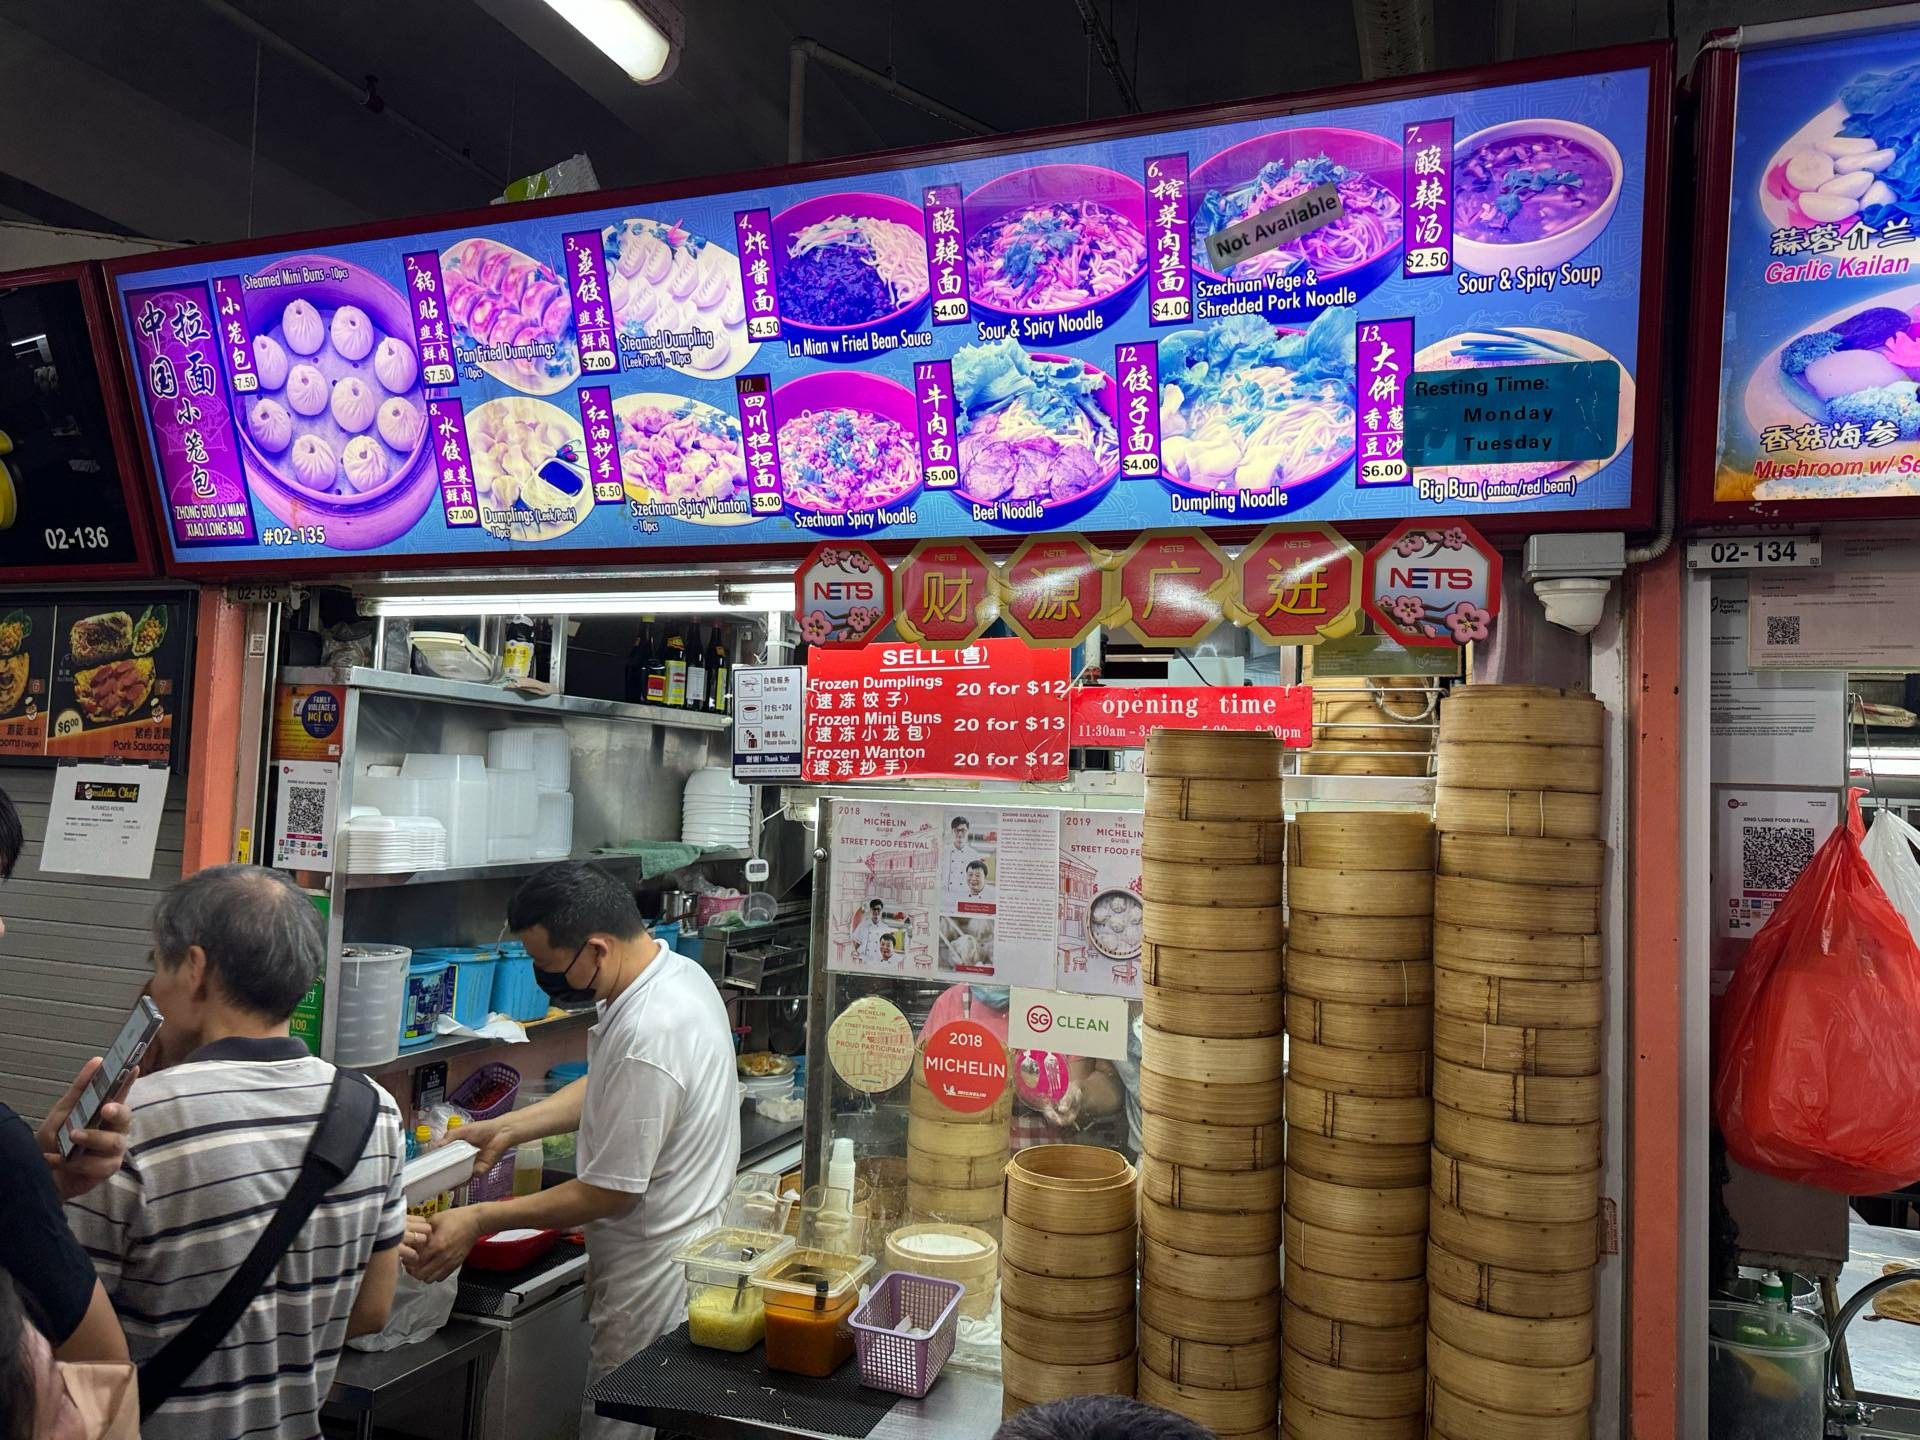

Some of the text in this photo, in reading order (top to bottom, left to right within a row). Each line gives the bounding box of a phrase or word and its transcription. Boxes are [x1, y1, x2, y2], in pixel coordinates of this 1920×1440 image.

[1410, 145, 1447, 244] 酸辣汤
[1149, 178, 1187, 293] 榨菜肉丝面
[1216, 194, 1337, 258] Not Available
[1770, 218, 1916, 256] 蒜蓉介兰
[931, 207, 963, 295] 酸辣面
[1405, 252, 1449, 268] $2.50
[244, 267, 325, 290] Steamed Mini Buns
[577, 248, 603, 303] 蒸饺
[744, 231, 774, 312] 炸酱面
[1458, 262, 1602, 294] Sour Spicy Soup
[1765, 256, 1910, 285] Garlic Kailan
[412, 270, 438, 319] 锅贴
[1198, 272, 1301, 298] Szechuan Vege
[933, 303, 966, 318] $4.00
[1152, 301, 1191, 317] $4.00
[1198, 286, 1357, 318] Shredded Pork Noodle
[221, 297, 251, 371] 小笼包
[748, 320, 780, 335] $4.50
[978, 311, 1103, 341] Sour Spicy Noodle
[170, 301, 217, 397] 拉面
[620, 328, 714, 351] Steamed Dumpling
[788, 329, 932, 357] La Mian Fried Bean Sauce
[138, 304, 177, 398] 中国
[456, 339, 555, 363] Pan Fried Dumplings
[582, 356, 611, 369] $7.00
[623, 353, 666, 371] (Leek/Pork)
[232, 375, 257, 389] $7.50
[424, 367, 452, 382] $7.50
[1367, 341, 1399, 405] 大饼
[1415, 376, 1550, 398] Resting Time:
[1122, 365, 1155, 452] 饺子面
[1464, 408, 1554, 423] Monday
[922, 383, 952, 462] 牛肉面
[438, 416, 463, 463] 水饺
[587, 405, 615, 480] 红油抄手
[743, 395, 776, 489] 四川担担面
[1464, 436, 1553, 452] Tuesday
[1761, 420, 1901, 452] 香菇海参
[176, 398, 218, 498] 小笼包
[924, 470, 956, 482] $5.00
[1362, 463, 1403, 478] $6.00
[1754, 459, 1864, 480] Mushroom
[593, 485, 621, 498] $6.50
[1419, 475, 1577, 502] Big Bun (onion/red bean)
[175, 503, 247, 519] ZHONG GUO LA MIAN
[631, 497, 748, 518] Szechuan Wanton
[751, 496, 781, 508] $5.00
[972, 501, 1044, 521] Beef Noodle
[1171, 487, 1288, 514] Dumpling Noodle
[448, 510, 474, 521] $7.00
[484, 507, 534, 525] Dumplings
[847, 505, 917, 529] Spicy Noodle
[45, 527, 109, 550] 02-136
[186, 521, 245, 537] XIAO LONG BAO
[262, 526, 326, 546] #02-135
[1711, 542, 1797, 562] 02-134
[1390, 568, 1472, 589] NETS
[237, 586, 278, 600] 02-135
[814, 581, 874, 601] NETS
[923, 556, 1328, 624] 财 源 广 进
[882, 646, 988, 666] SELL (售)
[810, 674, 1066, 697] Frozen Dumplings 20 for $12
[1102, 693, 1276, 718] opening time
[809, 711, 1066, 732] Frozen Mini Buns 20 for $13
[1079, 725, 1126, 737] 11:30am
[114, 740, 169, 753] Pork Sausage
[807, 745, 1065, 767] Frozen Wanton 20 for $12
[839, 807, 860, 815] 2018
[1066, 816, 1091, 826] 2019
[864, 818, 906, 826] MICHELIN
[841, 837, 928, 850] STREET FOOD FESTIVAL
[1097, 828, 1144, 838] MICHELIN
[1071, 844, 1101, 853] STREET
[1104, 847, 1128, 855] FOOD
[1031, 1012, 1109, 1033] SG CLEAN
[836, 1040, 905, 1054] PROUD PARTICIPANT
[949, 1032, 982, 1048] 2018
[926, 1057, 1006, 1079] MICHELIN
